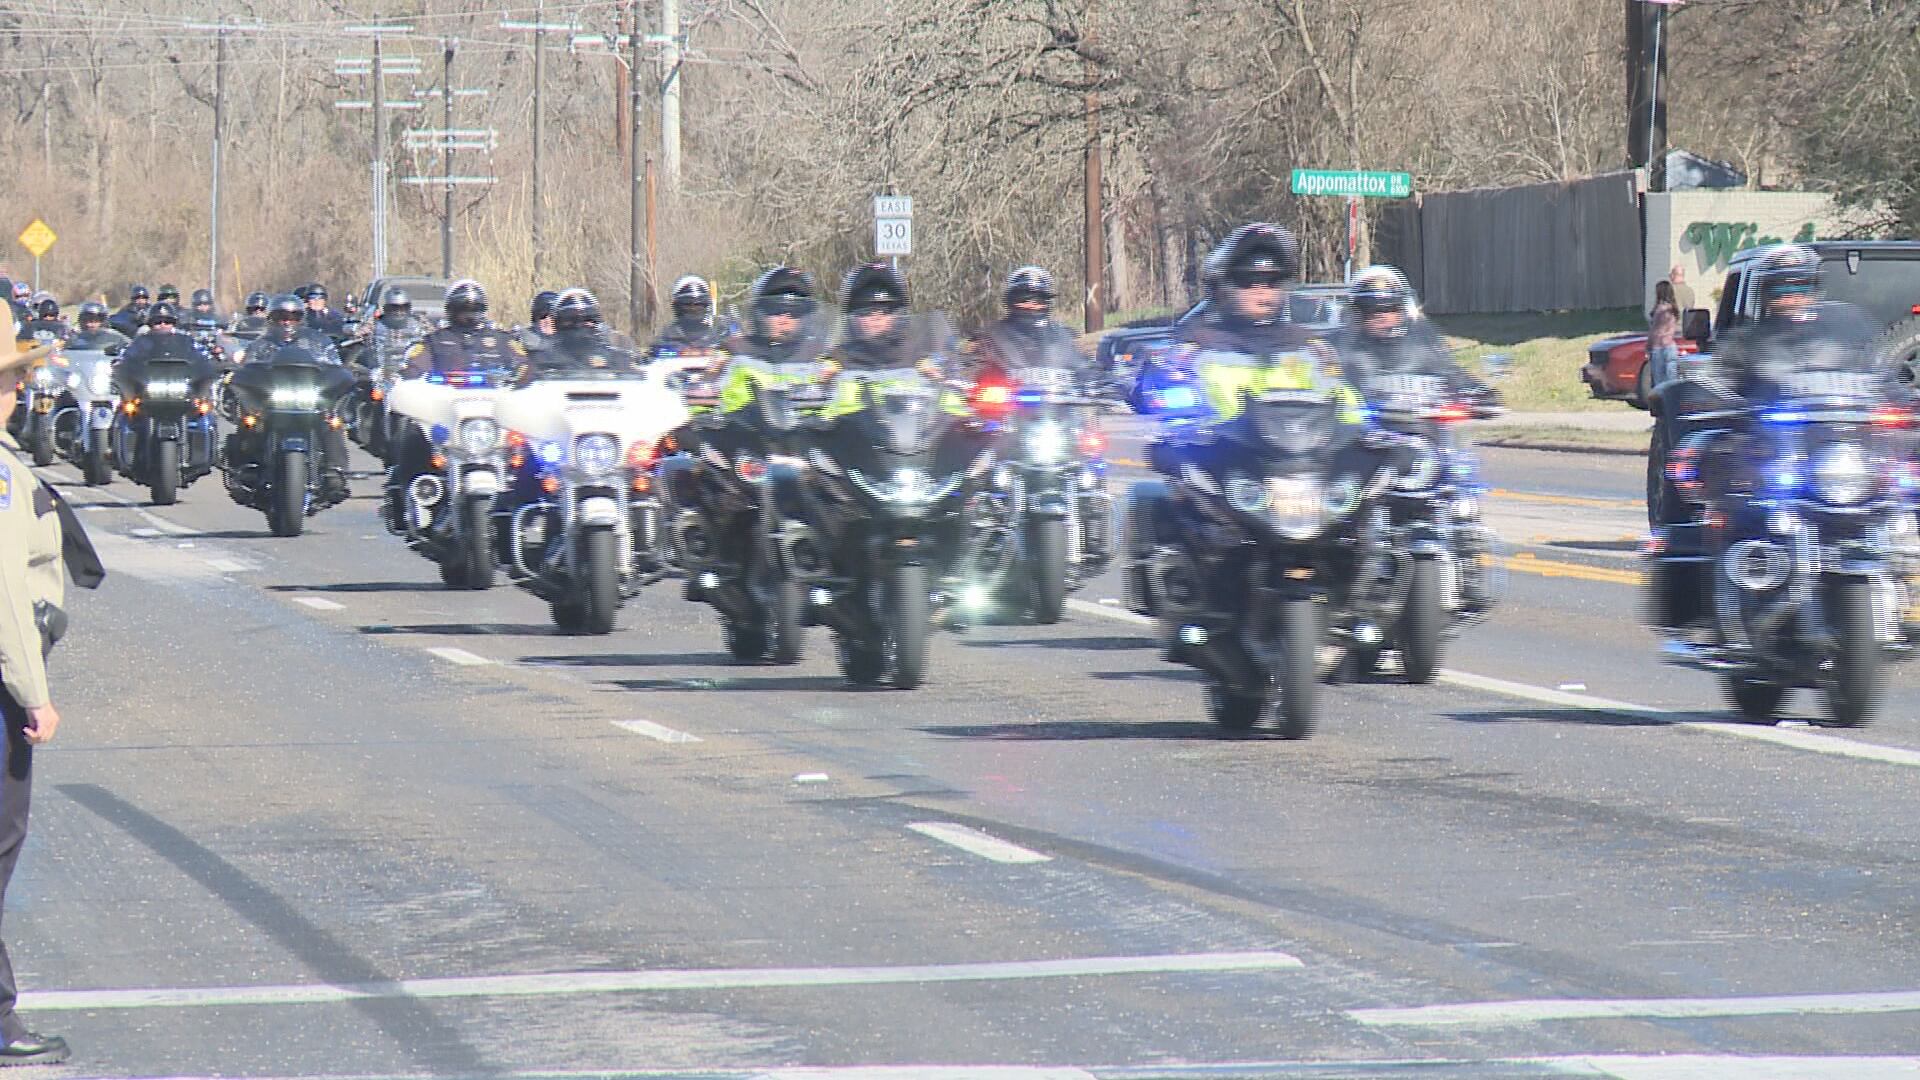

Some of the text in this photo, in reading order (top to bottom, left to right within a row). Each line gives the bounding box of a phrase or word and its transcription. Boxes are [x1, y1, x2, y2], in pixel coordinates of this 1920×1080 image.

[1297, 172, 1402, 195] Appomattox DR
[880, 200, 906, 212] EAST
[883, 223, 906, 240] 30
